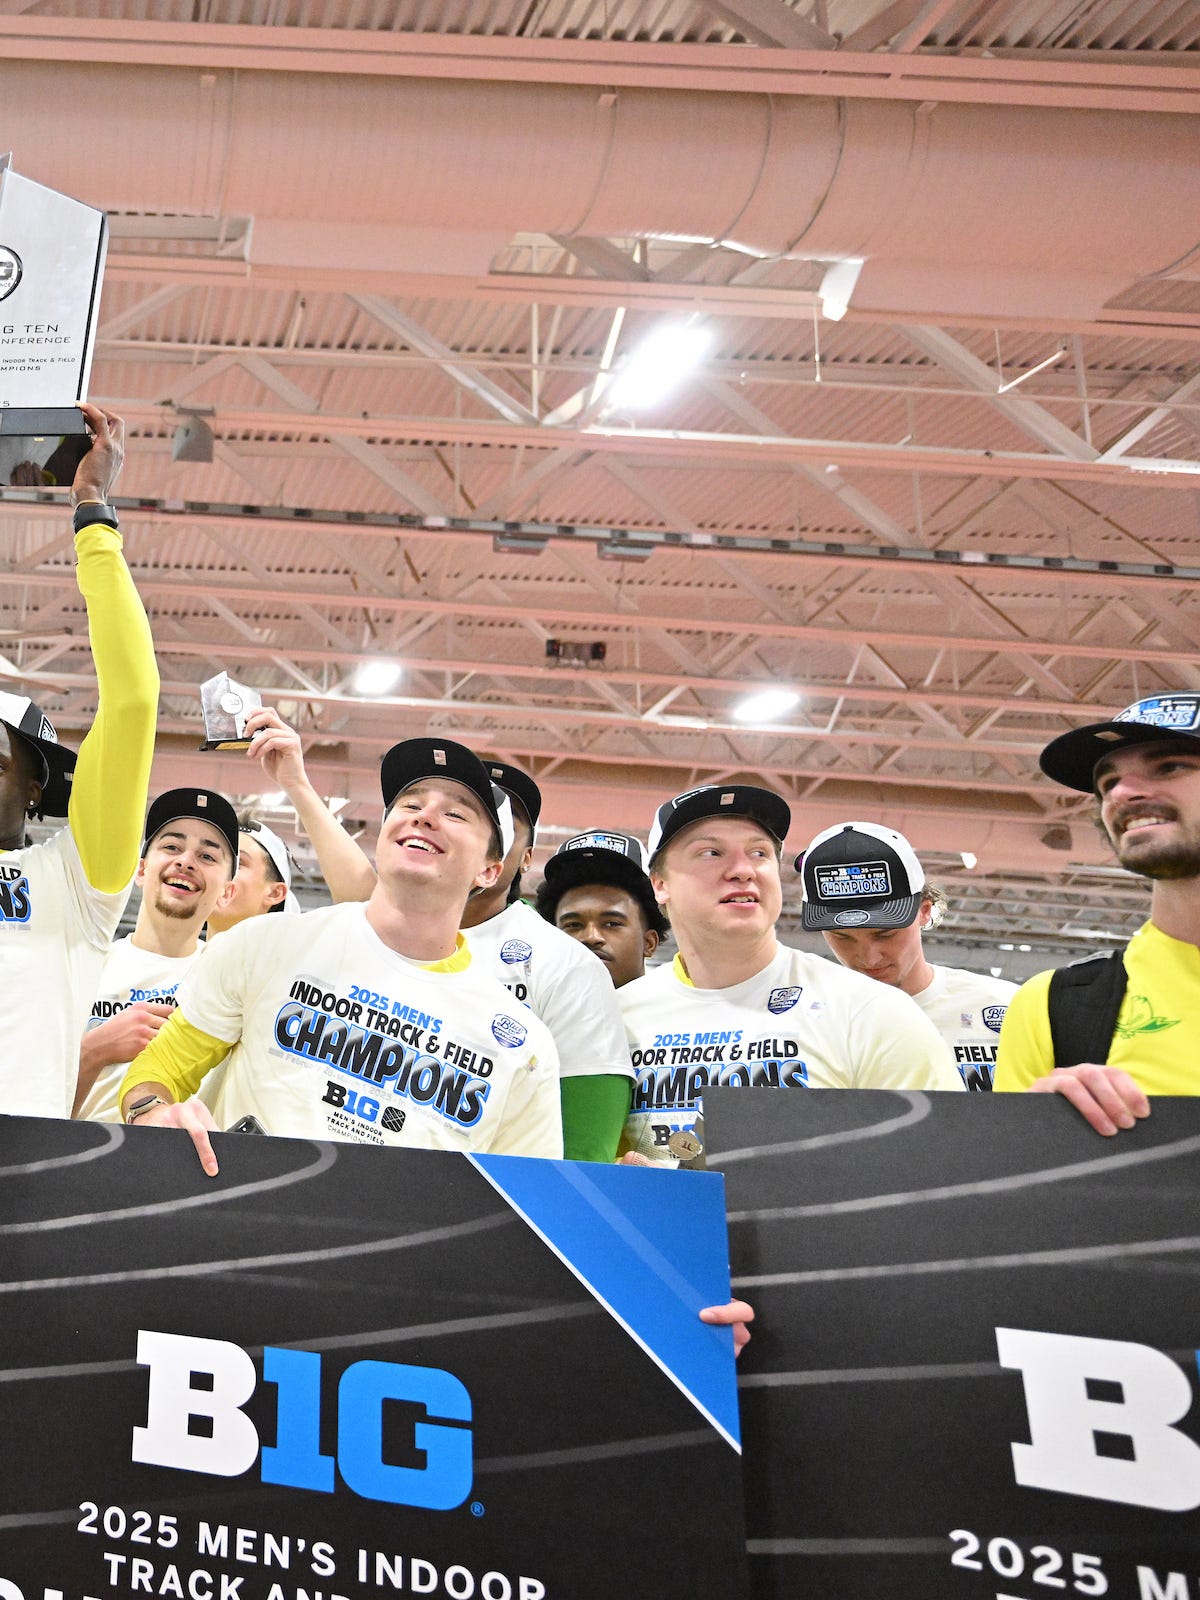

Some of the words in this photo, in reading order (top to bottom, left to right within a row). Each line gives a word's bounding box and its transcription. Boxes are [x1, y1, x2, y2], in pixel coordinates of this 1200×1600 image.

[24, 324, 59, 334] TEN
[821, 877, 887, 896] CHAMPIONS
[129, 988, 160, 1002] 2025
[348, 984, 390, 1011] 2025
[391, 1002, 443, 1034] MEN'S
[289, 980, 363, 1024] INDOOR
[366, 1008, 425, 1049] TRACK
[425, 1035, 440, 1054] &
[443, 1041, 494, 1078] FIELD
[497, 1016, 524, 1034] Blue
[653, 1033, 690, 1048] 2025
[693, 1029, 743, 1046] MEN'S
[274, 1001, 492, 1128] CHAMPIONS
[671, 1045, 725, 1064] TRACK
[729, 1044, 743, 1061] &
[747, 1038, 798, 1060] FIELD
[326, 1116, 349, 1130] TRACK
[351, 1127, 366, 1137] AND
[366, 1133, 385, 1145] FIELD
[333, 1111, 356, 1125] MEN'S
[357, 1122, 383, 1137] INDOOR
[76, 1501, 178, 1549] 2025
[197, 1521, 336, 1576] MEN'S
[357, 1548, 548, 1600] INDOOR
[949, 1529, 1108, 1596] 2025
[103, 1552, 247, 1600] TRACK
